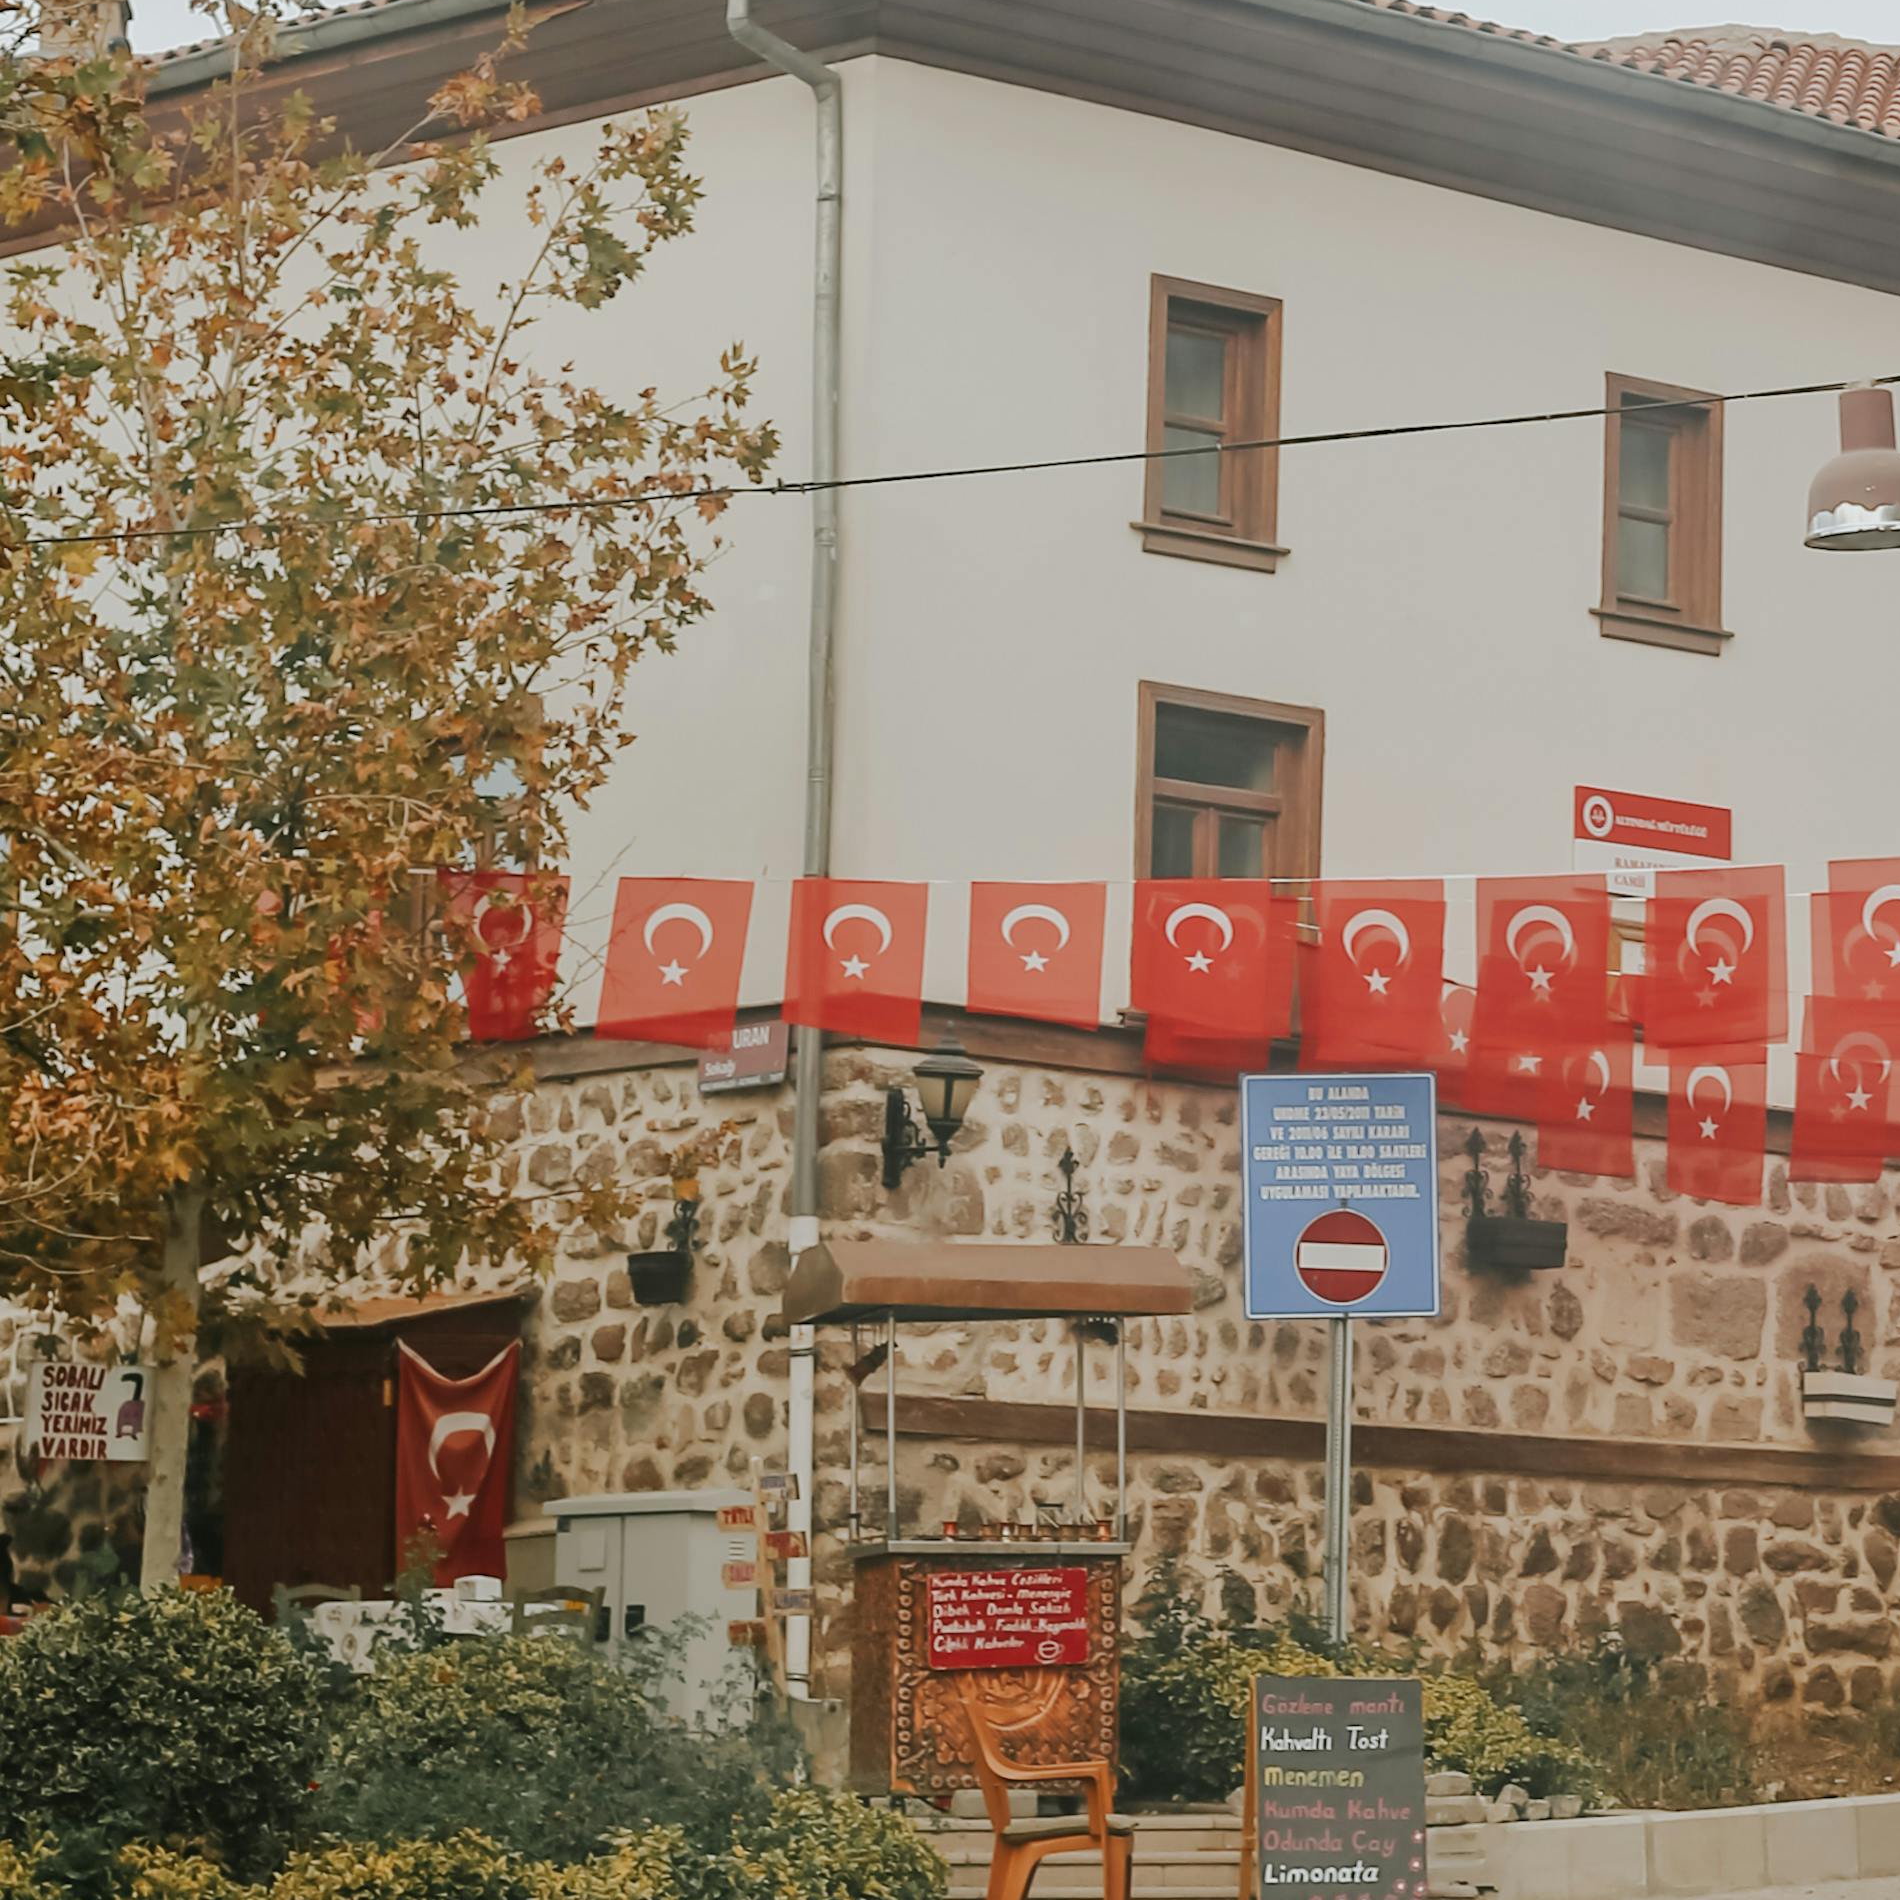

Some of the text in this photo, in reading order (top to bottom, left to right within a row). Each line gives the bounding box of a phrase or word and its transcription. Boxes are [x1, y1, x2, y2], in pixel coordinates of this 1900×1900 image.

[1308, 1086, 1369, 1100] BU ALANDA
[1270, 1126, 1284, 1140] VE
[1275, 1165, 1329, 1180] ARASINDA
[1333, 1165, 1359, 1179] YAYA
[1260, 1185, 1329, 1200] UYGULAMASI
[42, 1365, 106, 1390] SOBALI
[41, 1391, 95, 1412] SICAK
[42, 1436, 108, 1459] VARDIR
[1349, 1691, 1405, 1714] mantı
[1260, 1725, 1389, 1751] Kahvaltı Tost
[1264, 1797, 1411, 1820] Kumda Kahve
[1263, 1830, 1398, 1858] Odunda Çay
[1263, 1861, 1380, 1884] Limonata
